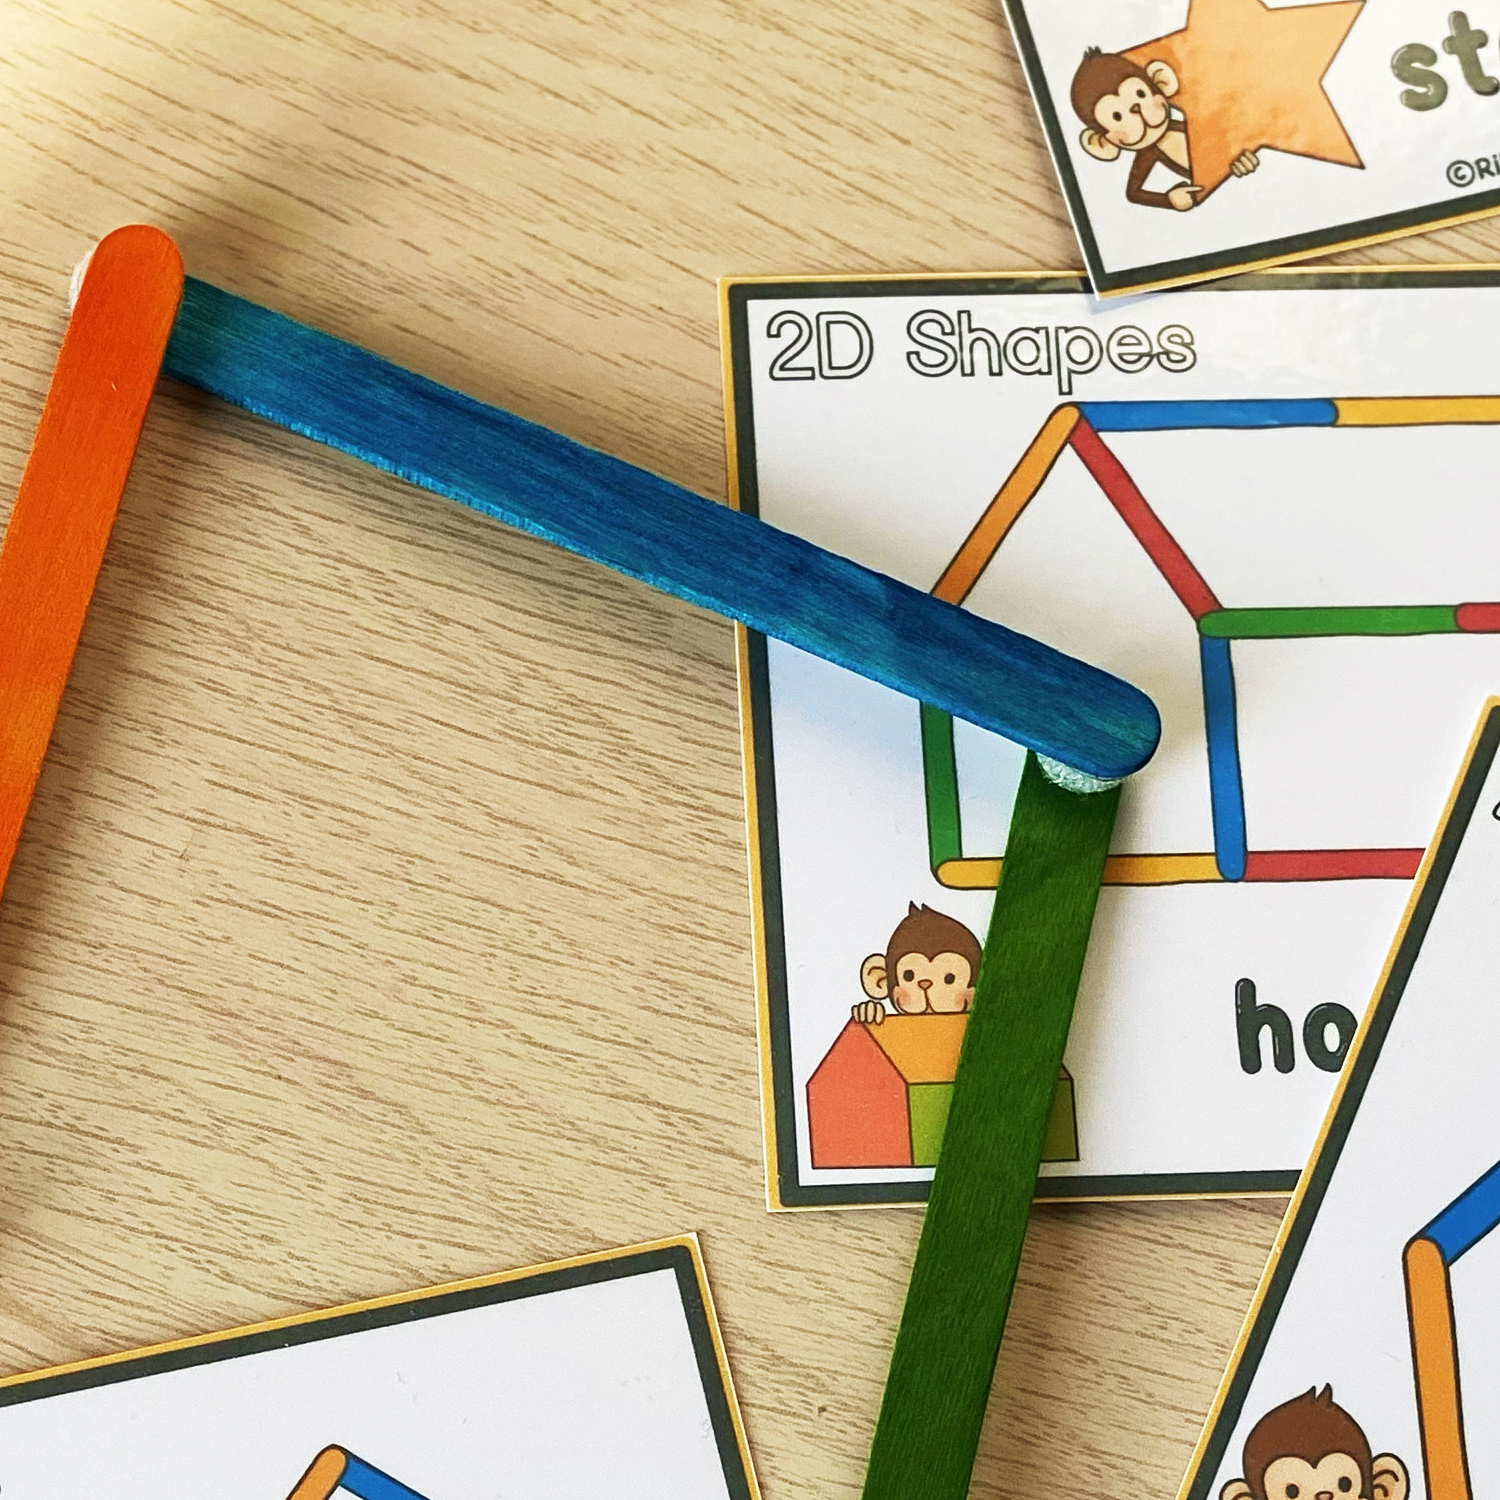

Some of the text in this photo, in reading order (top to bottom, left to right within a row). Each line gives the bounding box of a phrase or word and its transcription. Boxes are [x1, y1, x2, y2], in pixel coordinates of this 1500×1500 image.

[1390, 10, 1500, 112] st
[1446, 153, 1500, 188] ©Ri
[766, 309, 1197, 396] 2D Shapes
